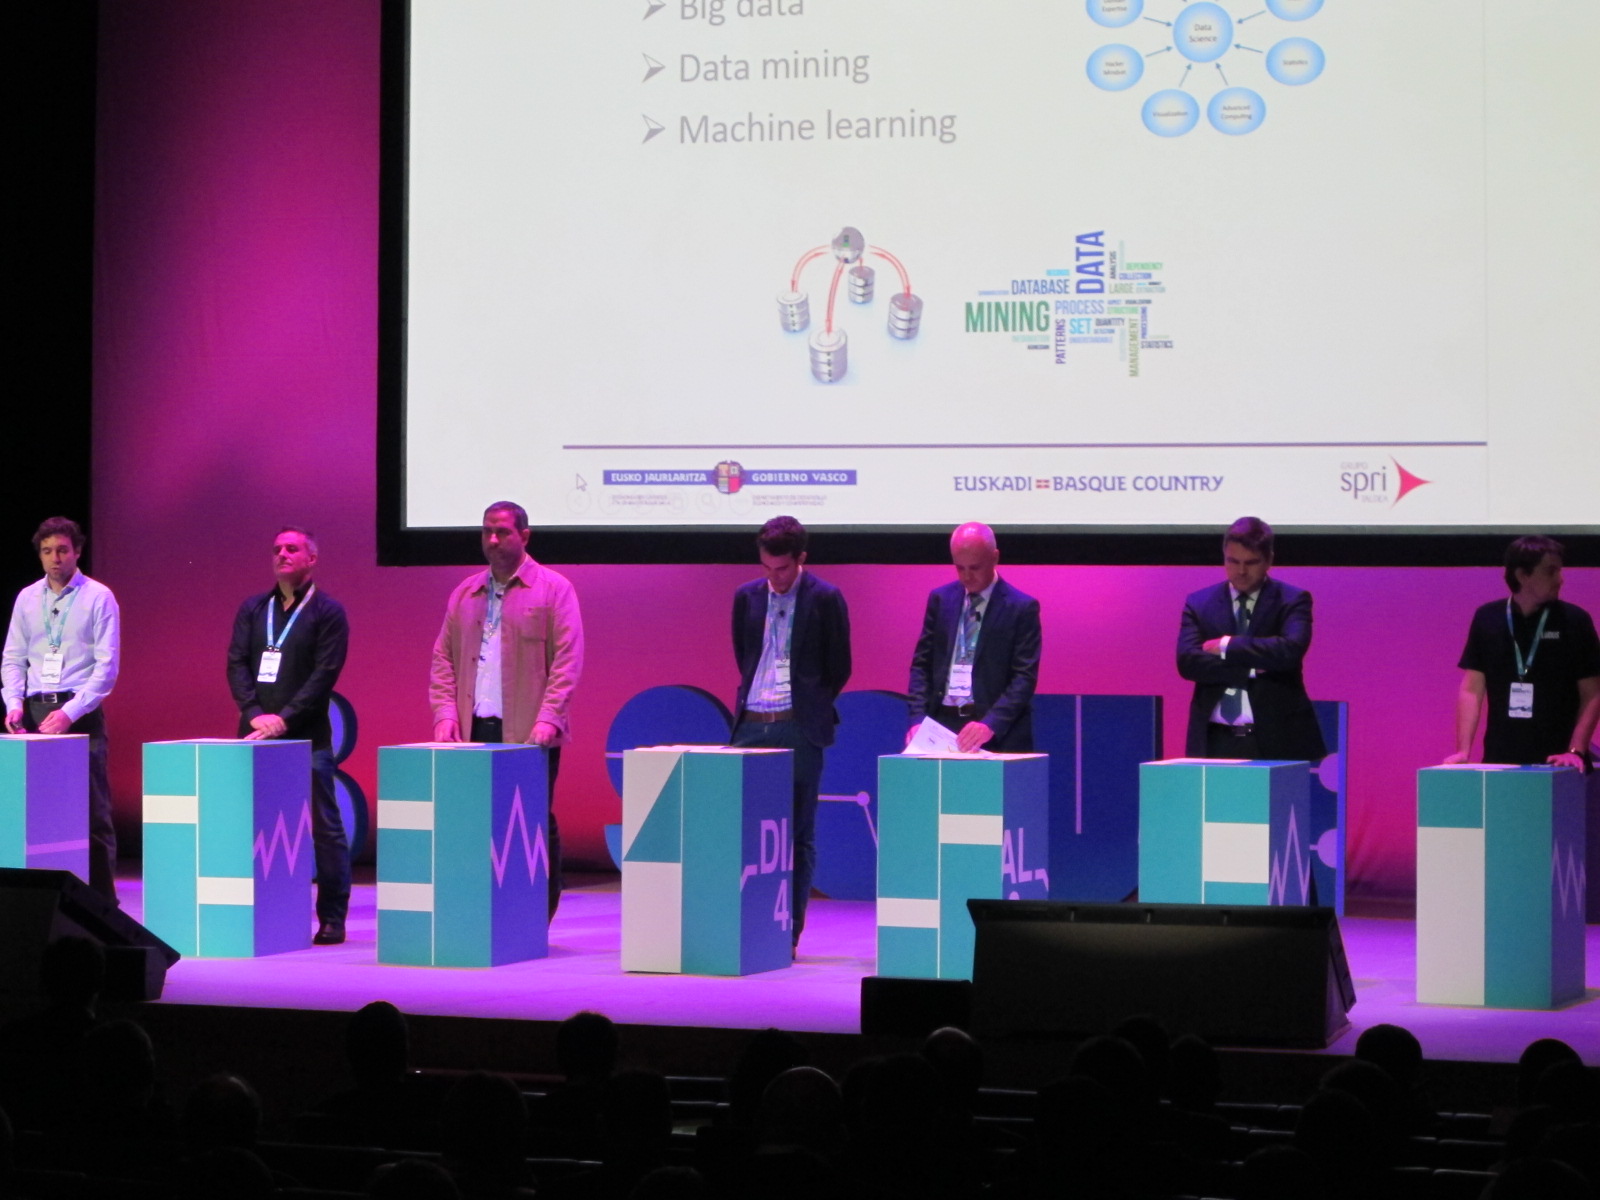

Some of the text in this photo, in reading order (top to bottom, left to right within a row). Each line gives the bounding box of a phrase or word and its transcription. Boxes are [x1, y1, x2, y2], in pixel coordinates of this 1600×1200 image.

[680, 0, 804, 26] Big data
[1189, 34, 1217, 43] Science
[1194, 24, 1212, 32] Data
[680, 49, 870, 84] Data mining
[679, 108, 957, 144] Machine learning
[1075, 230, 1105, 294] DATA
[1011, 279, 1070, 295] DATABASE
[965, 300, 1050, 333] MINING
[1055, 299, 1105, 315] PROCESS
[1069, 318, 1092, 334] SET
[1055, 318, 1066, 365] PATTERNS
[1129, 317, 1139, 377] MANAGEMENT
[611, 472, 848, 483] EUSKO JAURLARITZA GOBIERNO VASCO
[953, 475, 1224, 493] EUSKADI BASQUE COUNTRY
[1341, 466, 1387, 500] spri
[760, 818, 793, 874] DI
